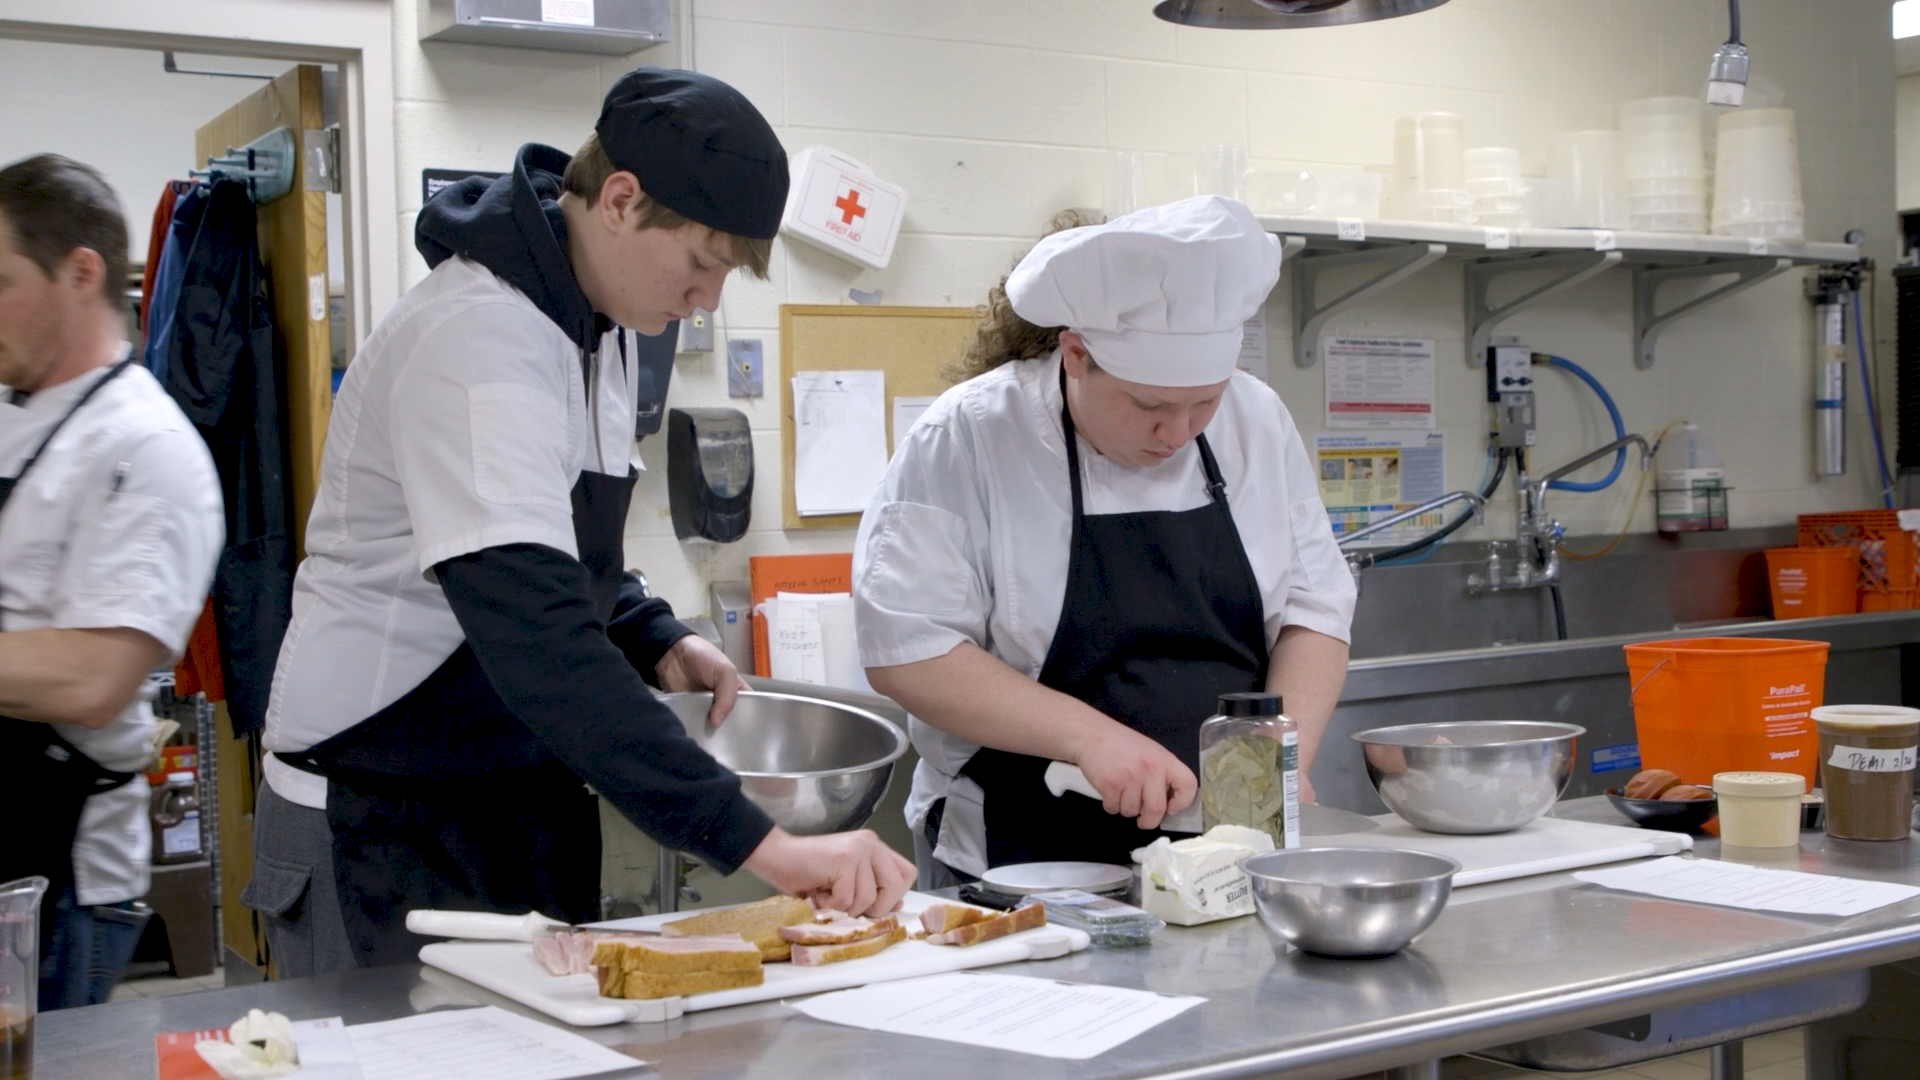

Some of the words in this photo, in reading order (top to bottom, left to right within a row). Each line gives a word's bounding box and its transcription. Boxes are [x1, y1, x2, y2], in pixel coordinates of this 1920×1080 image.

[825, 221, 846, 235] FIRST
[847, 230, 862, 242] AID
[780, 630, 808, 640] EXIT
[1770, 750, 1800, 760] impact
[1848, 753, 1885, 771] DEMI
[1225, 885, 1248, 903] BUTTER
